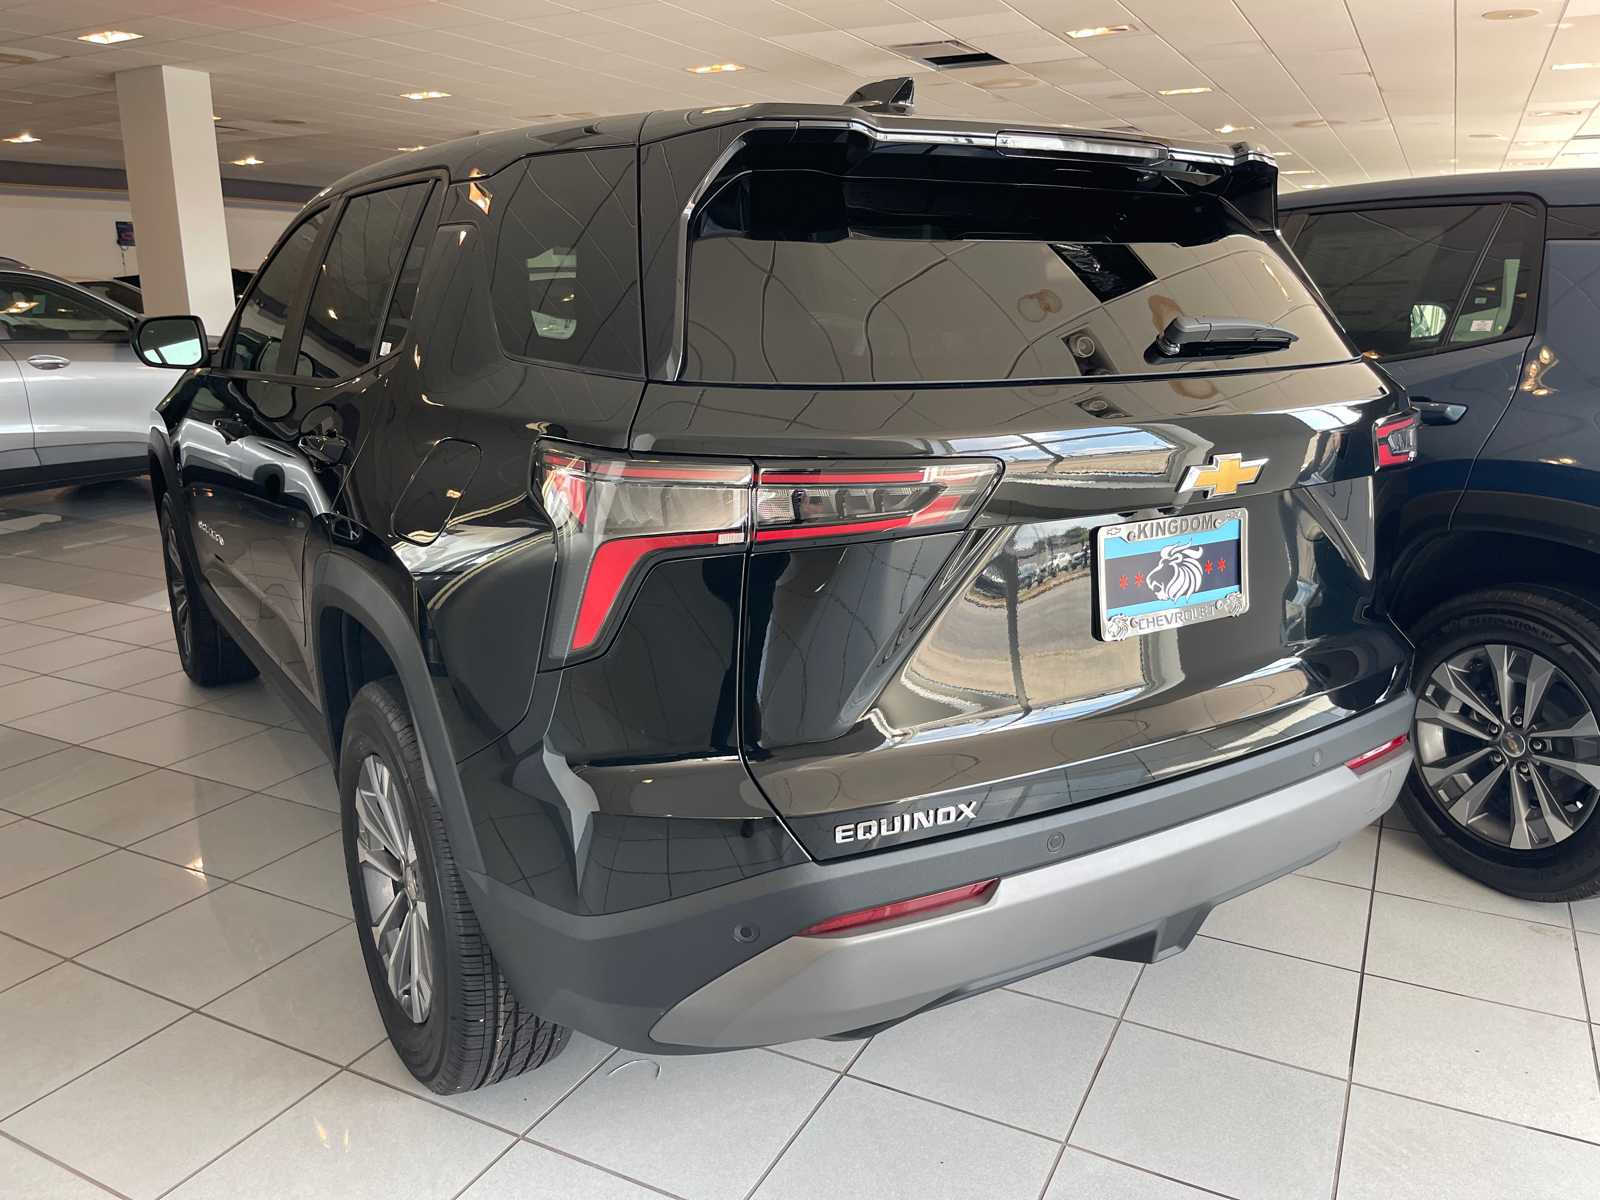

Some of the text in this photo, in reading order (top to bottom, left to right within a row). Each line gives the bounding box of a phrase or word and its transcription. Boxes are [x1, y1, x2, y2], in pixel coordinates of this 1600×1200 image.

[1137, 515, 1213, 539] KINGDOM
[1138, 604, 1215, 631] CHEVROLET
[834, 800, 977, 844] EQUINOX
